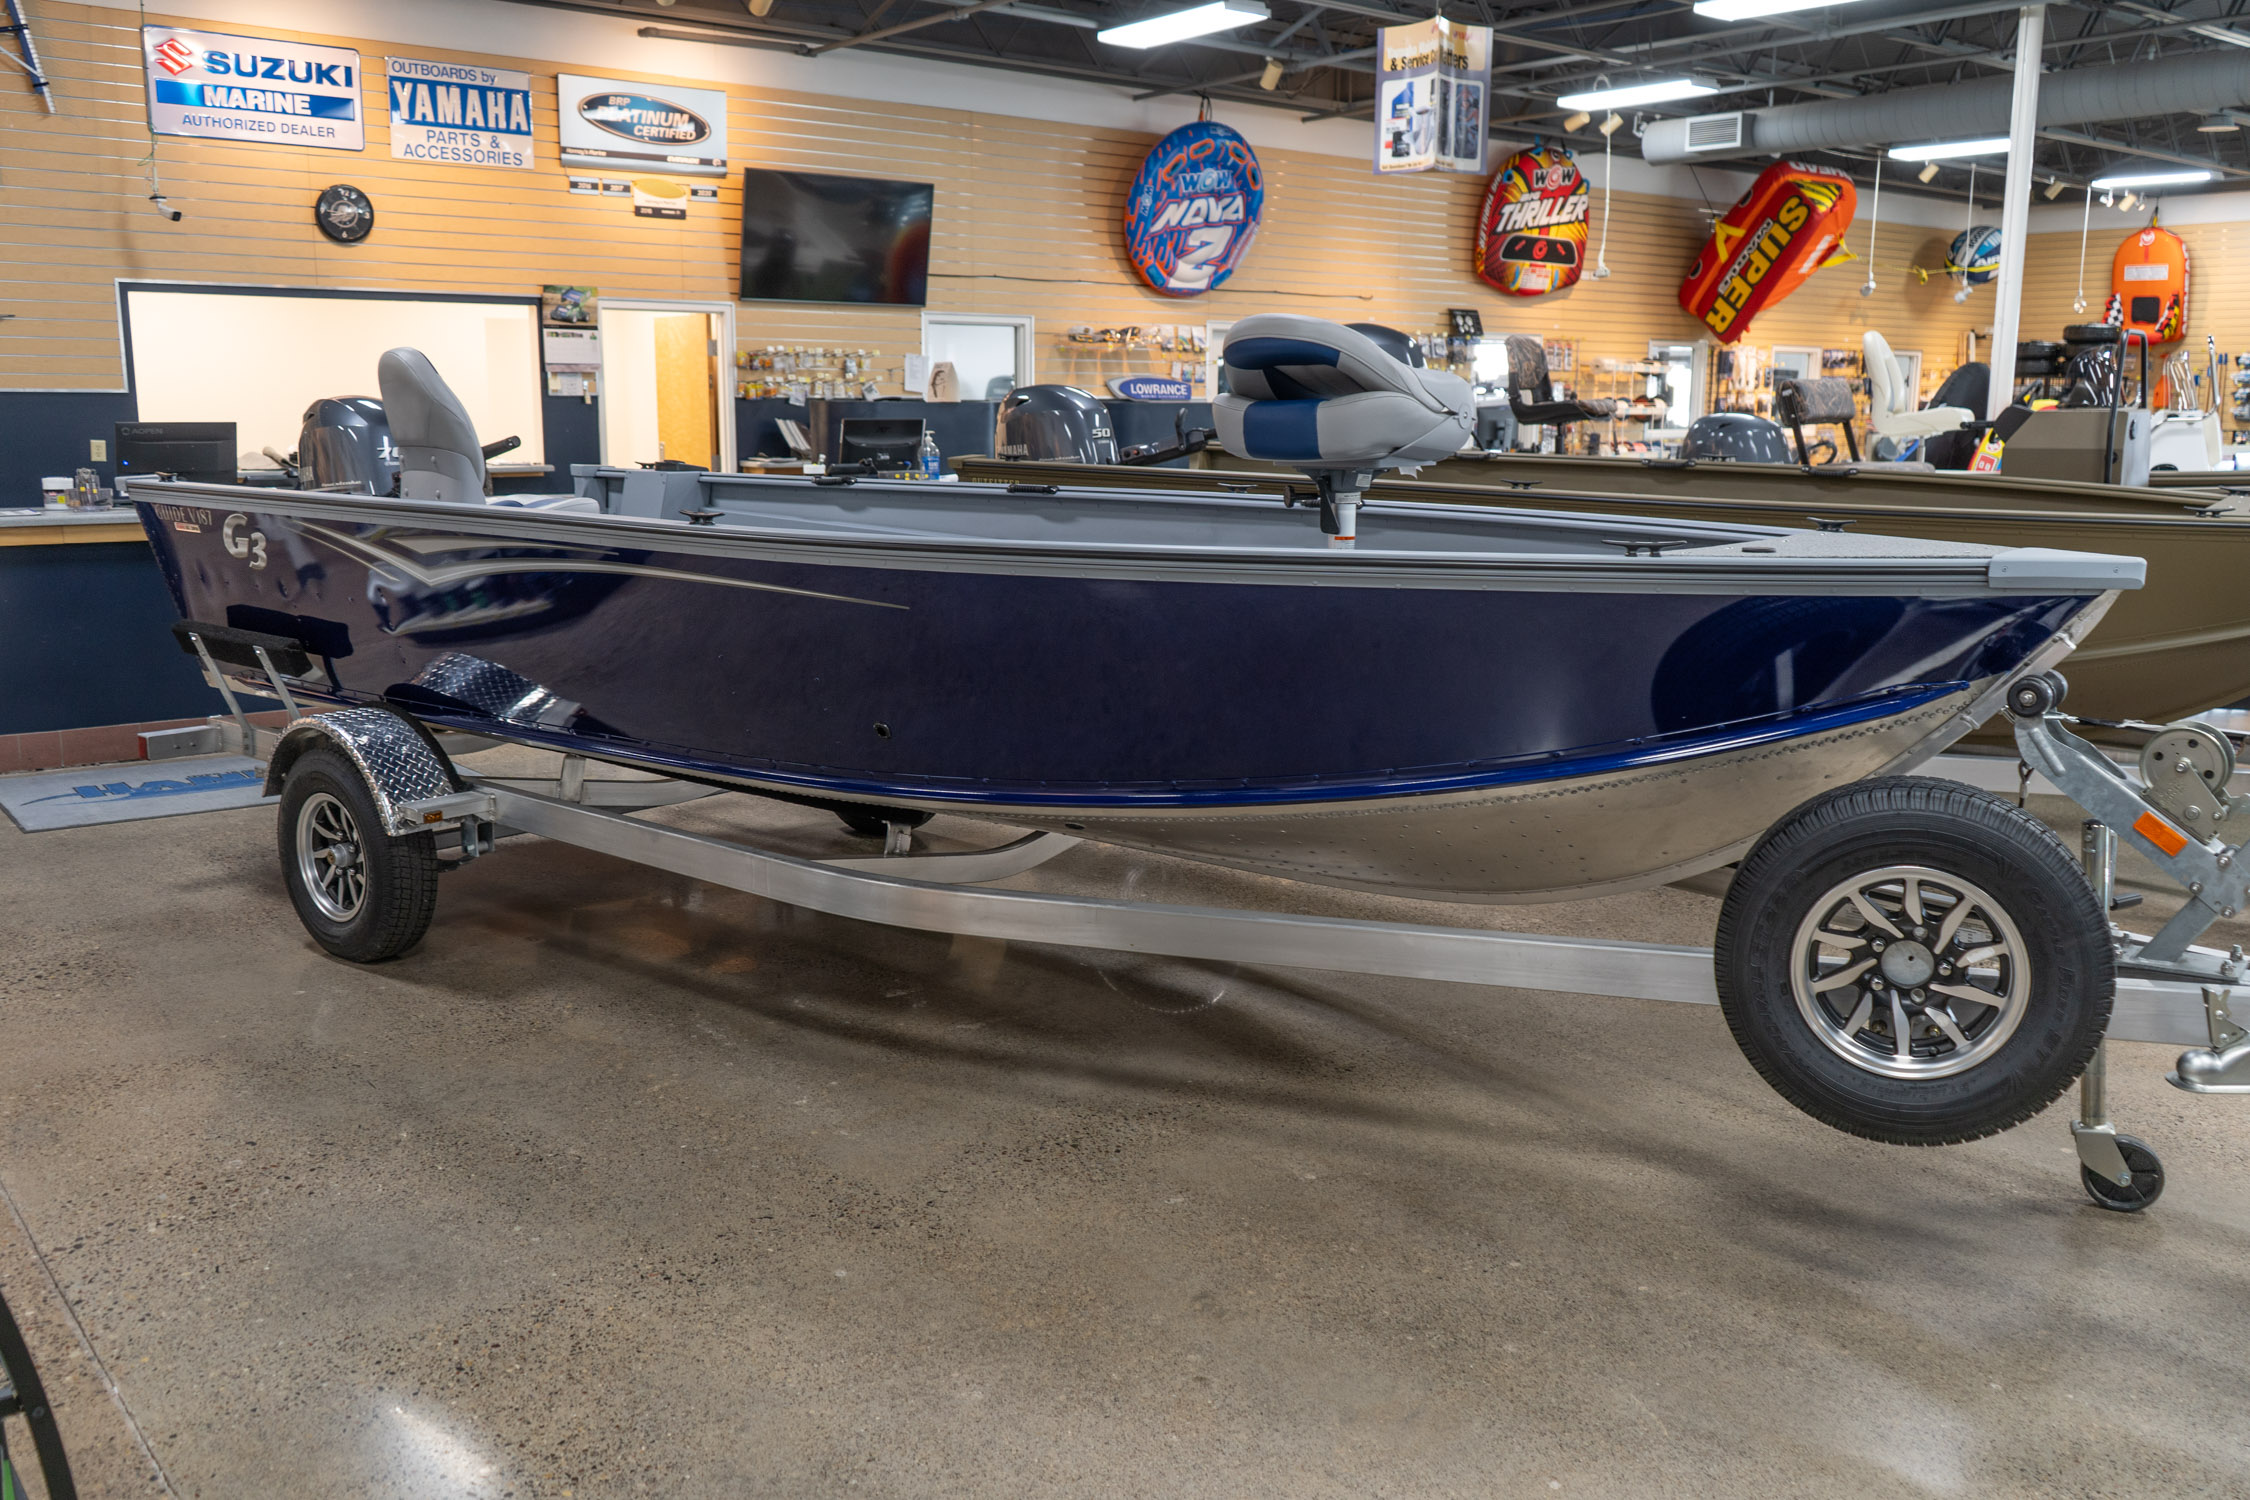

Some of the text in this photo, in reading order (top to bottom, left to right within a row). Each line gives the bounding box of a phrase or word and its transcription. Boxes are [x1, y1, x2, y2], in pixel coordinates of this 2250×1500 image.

[203, 50, 353, 88] SUZUKI
[391, 60, 497, 86] OUTBOARDS by
[203, 85, 312, 116] MARINE
[391, 80, 530, 132] YAMAHA
[608, 96, 631, 106] BRP
[182, 114, 336, 139] AUTHORIZED DEALER
[598, 105, 690, 128] ATINUM
[426, 129, 501, 149] PARTS &
[633, 125, 697, 141] CERTIFIED
[403, 143, 524, 167] ACCESSORIES
[1179, 168, 1233, 193] WOW
[1533, 164, 1576, 190] WOW
[1150, 195, 1245, 234] NOVA
[1495, 194, 1589, 234] THRILLER
[1704, 196, 1809, 335] SUPER
[1130, 383, 1188, 396] LOWRANCE
[1092, 428, 1111, 438] 50
[155, 503, 187, 522] GUIDE
[223, 513, 268, 571] G3
